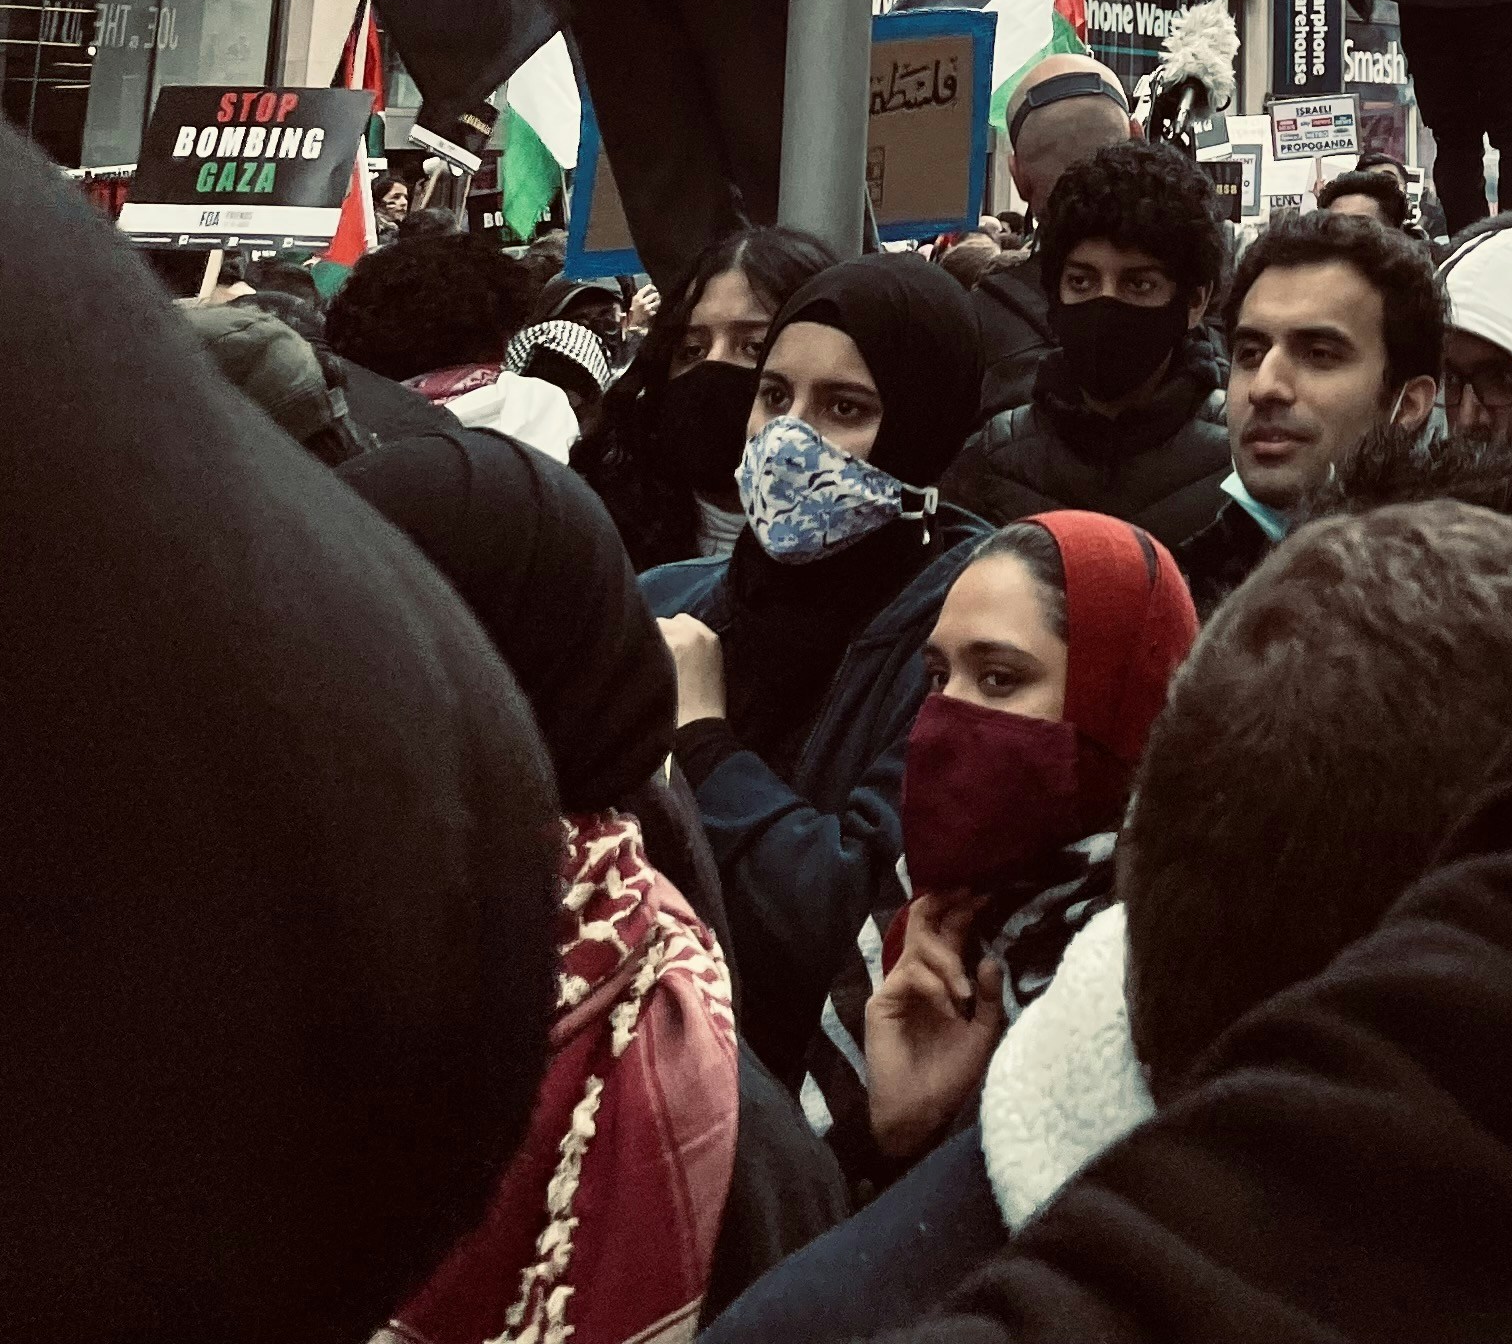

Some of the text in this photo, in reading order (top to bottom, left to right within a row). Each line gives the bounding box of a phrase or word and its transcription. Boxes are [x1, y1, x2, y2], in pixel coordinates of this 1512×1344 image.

[217, 91, 299, 123] STOP
[1296, 104, 1332, 117] ISRAELI
[172, 125, 326, 160] BOMBING
[1281, 138, 1354, 153] PROPOGANDA
[196, 161, 278, 194] GAZA
